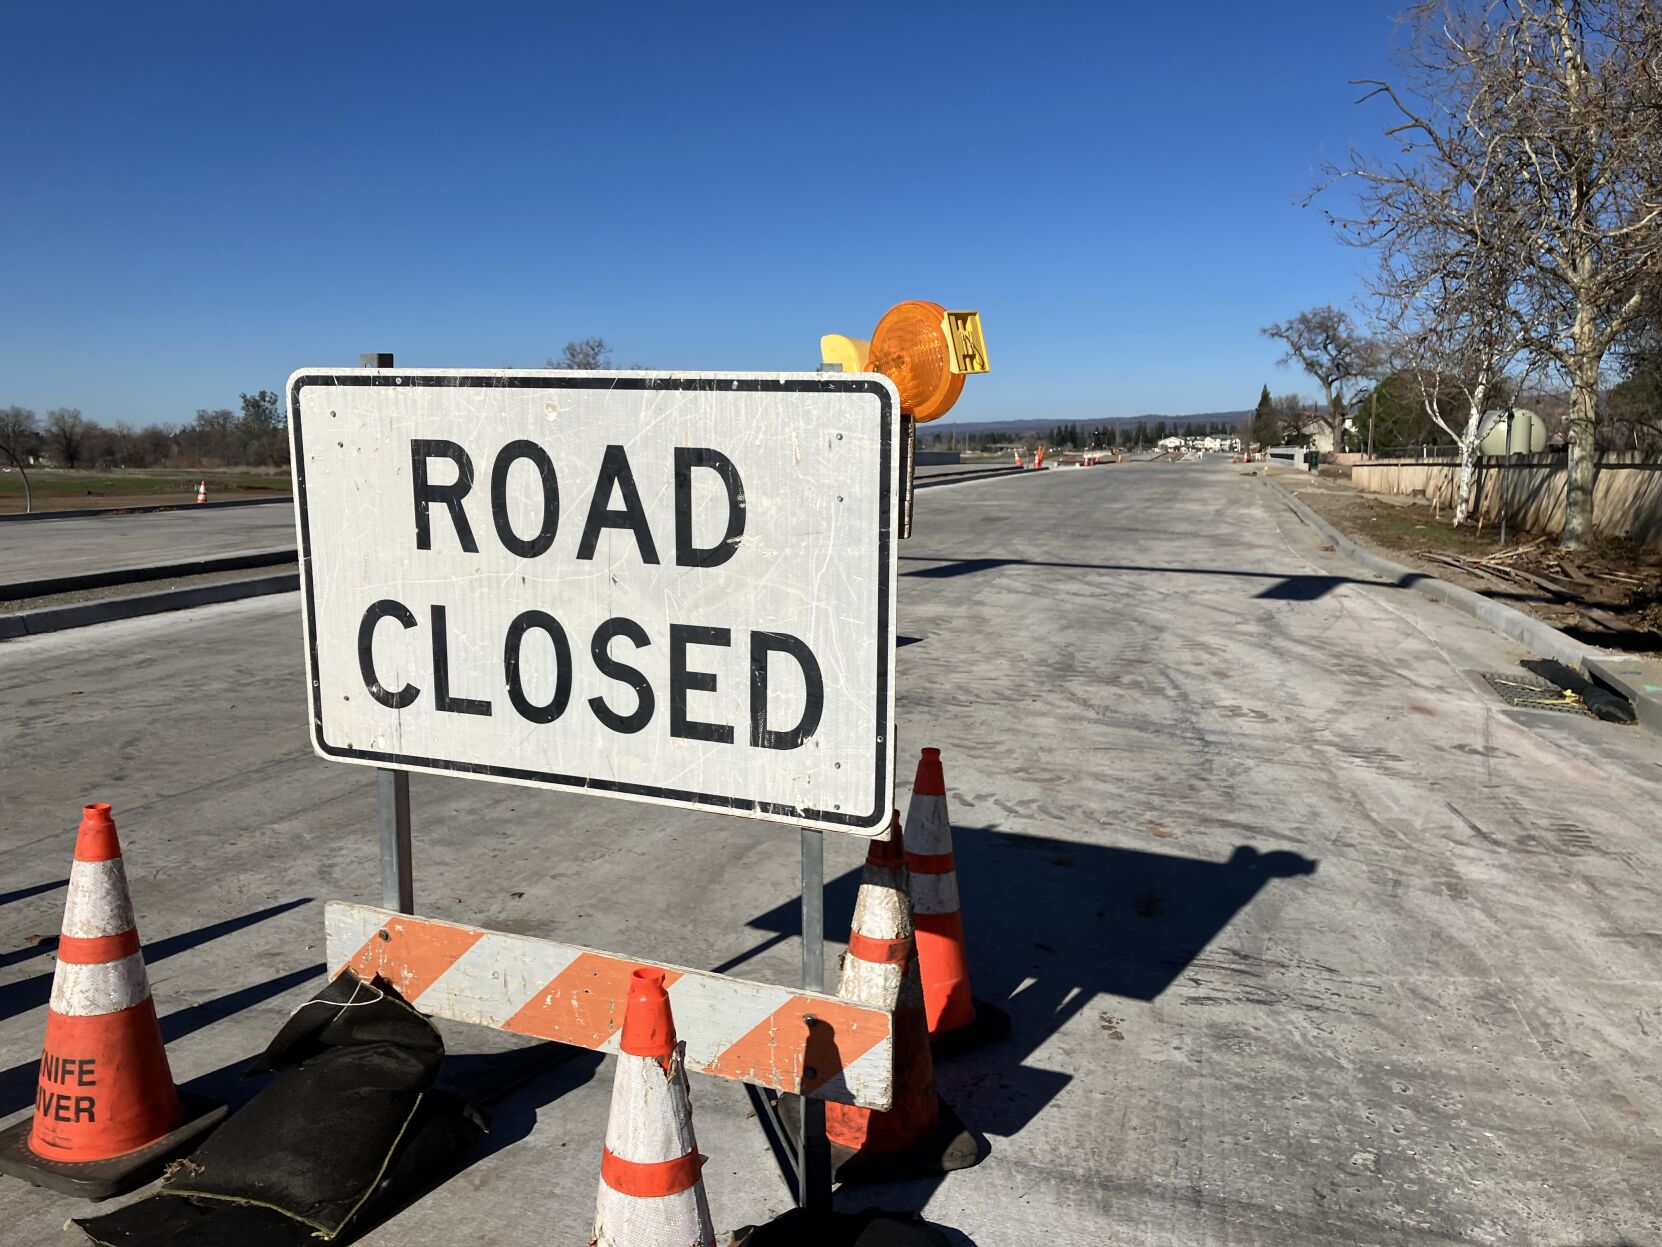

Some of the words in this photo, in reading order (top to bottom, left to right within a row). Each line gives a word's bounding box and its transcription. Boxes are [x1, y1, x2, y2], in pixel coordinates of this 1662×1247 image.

[410, 438, 747, 568] ROAD
[357, 599, 824, 751] CLOSED
[36, 1085, 96, 1123] IVER
[40, 1049, 97, 1087] NIFE
